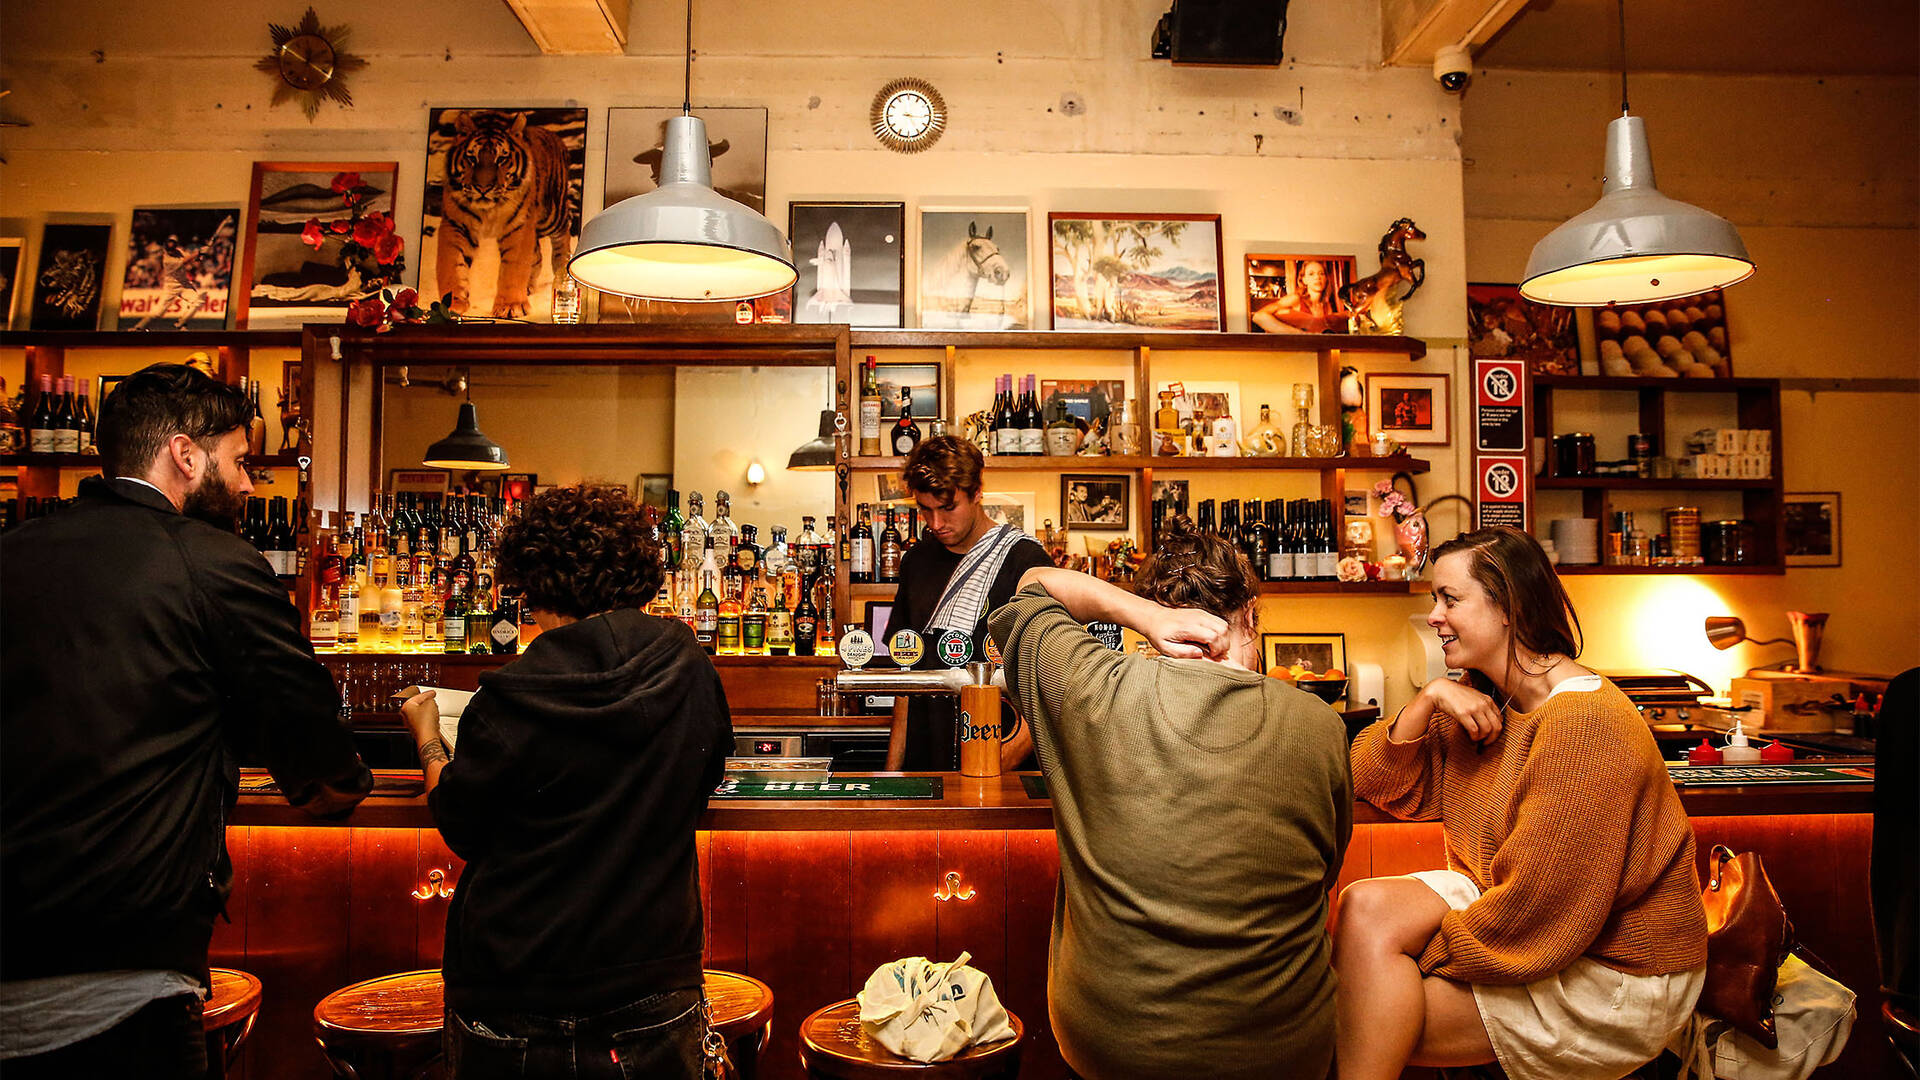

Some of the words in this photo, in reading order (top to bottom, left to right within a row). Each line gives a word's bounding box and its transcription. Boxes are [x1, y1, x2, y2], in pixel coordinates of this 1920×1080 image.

[1491, 380, 1508, 395] 18
[1492, 475, 1510, 491] 18
[681, 608, 691, 616] 12
[942, 633, 969, 644] VICTORIA
[948, 644, 964, 653] VB
[943, 654, 969, 664] BITTER
[961, 711, 1001, 743] Beer
[763, 782, 871, 791] BEER
